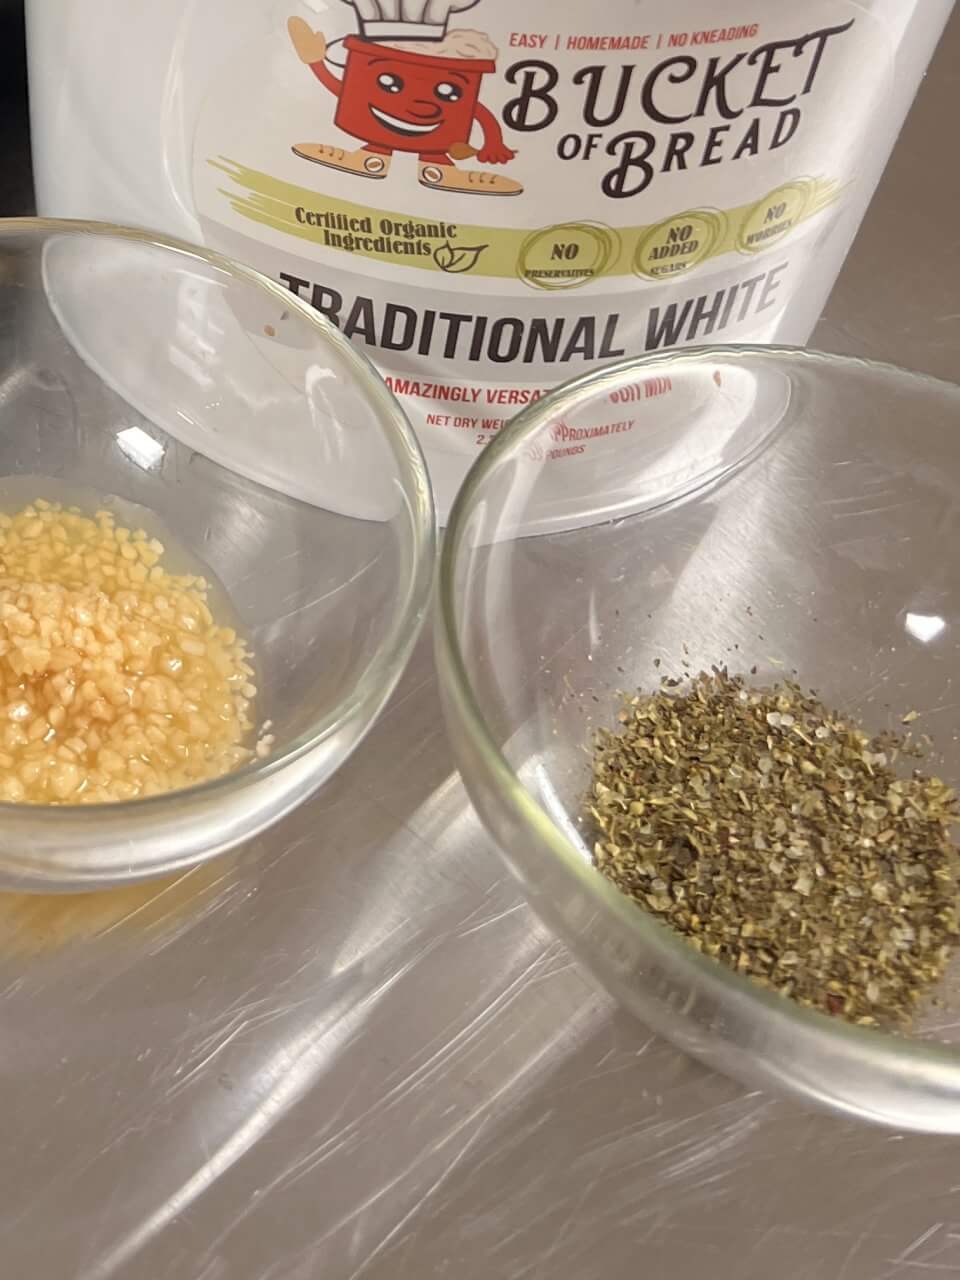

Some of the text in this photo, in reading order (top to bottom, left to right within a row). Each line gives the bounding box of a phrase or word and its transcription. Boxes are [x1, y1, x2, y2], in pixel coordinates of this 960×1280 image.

[509, 32, 547, 48] EASY
[566, 34, 651, 51] HOMEMADE
[667, 32, 688, 48] NO
[689, 23, 759, 46] KNEADING
[501, 18, 856, 132] BUCKET
[556, 107, 802, 199] OF BREAD
[294, 206, 458, 239] Certified Organic
[762, 201, 788, 224] NO
[322, 229, 433, 257] Ingredients
[665, 225, 693, 245] NO
[549, 242, 581, 261] NO
[648, 239, 700, 261] ADDED
[279, 261, 789, 364] TRADITIONAL WHITE
[385, 376, 483, 405] AMAZINGLY
[486, 388, 552, 406] VERSA
[426, 413, 452, 427] NET
[453, 417, 478, 430] DRY
[480, 418, 507, 431] WEI
